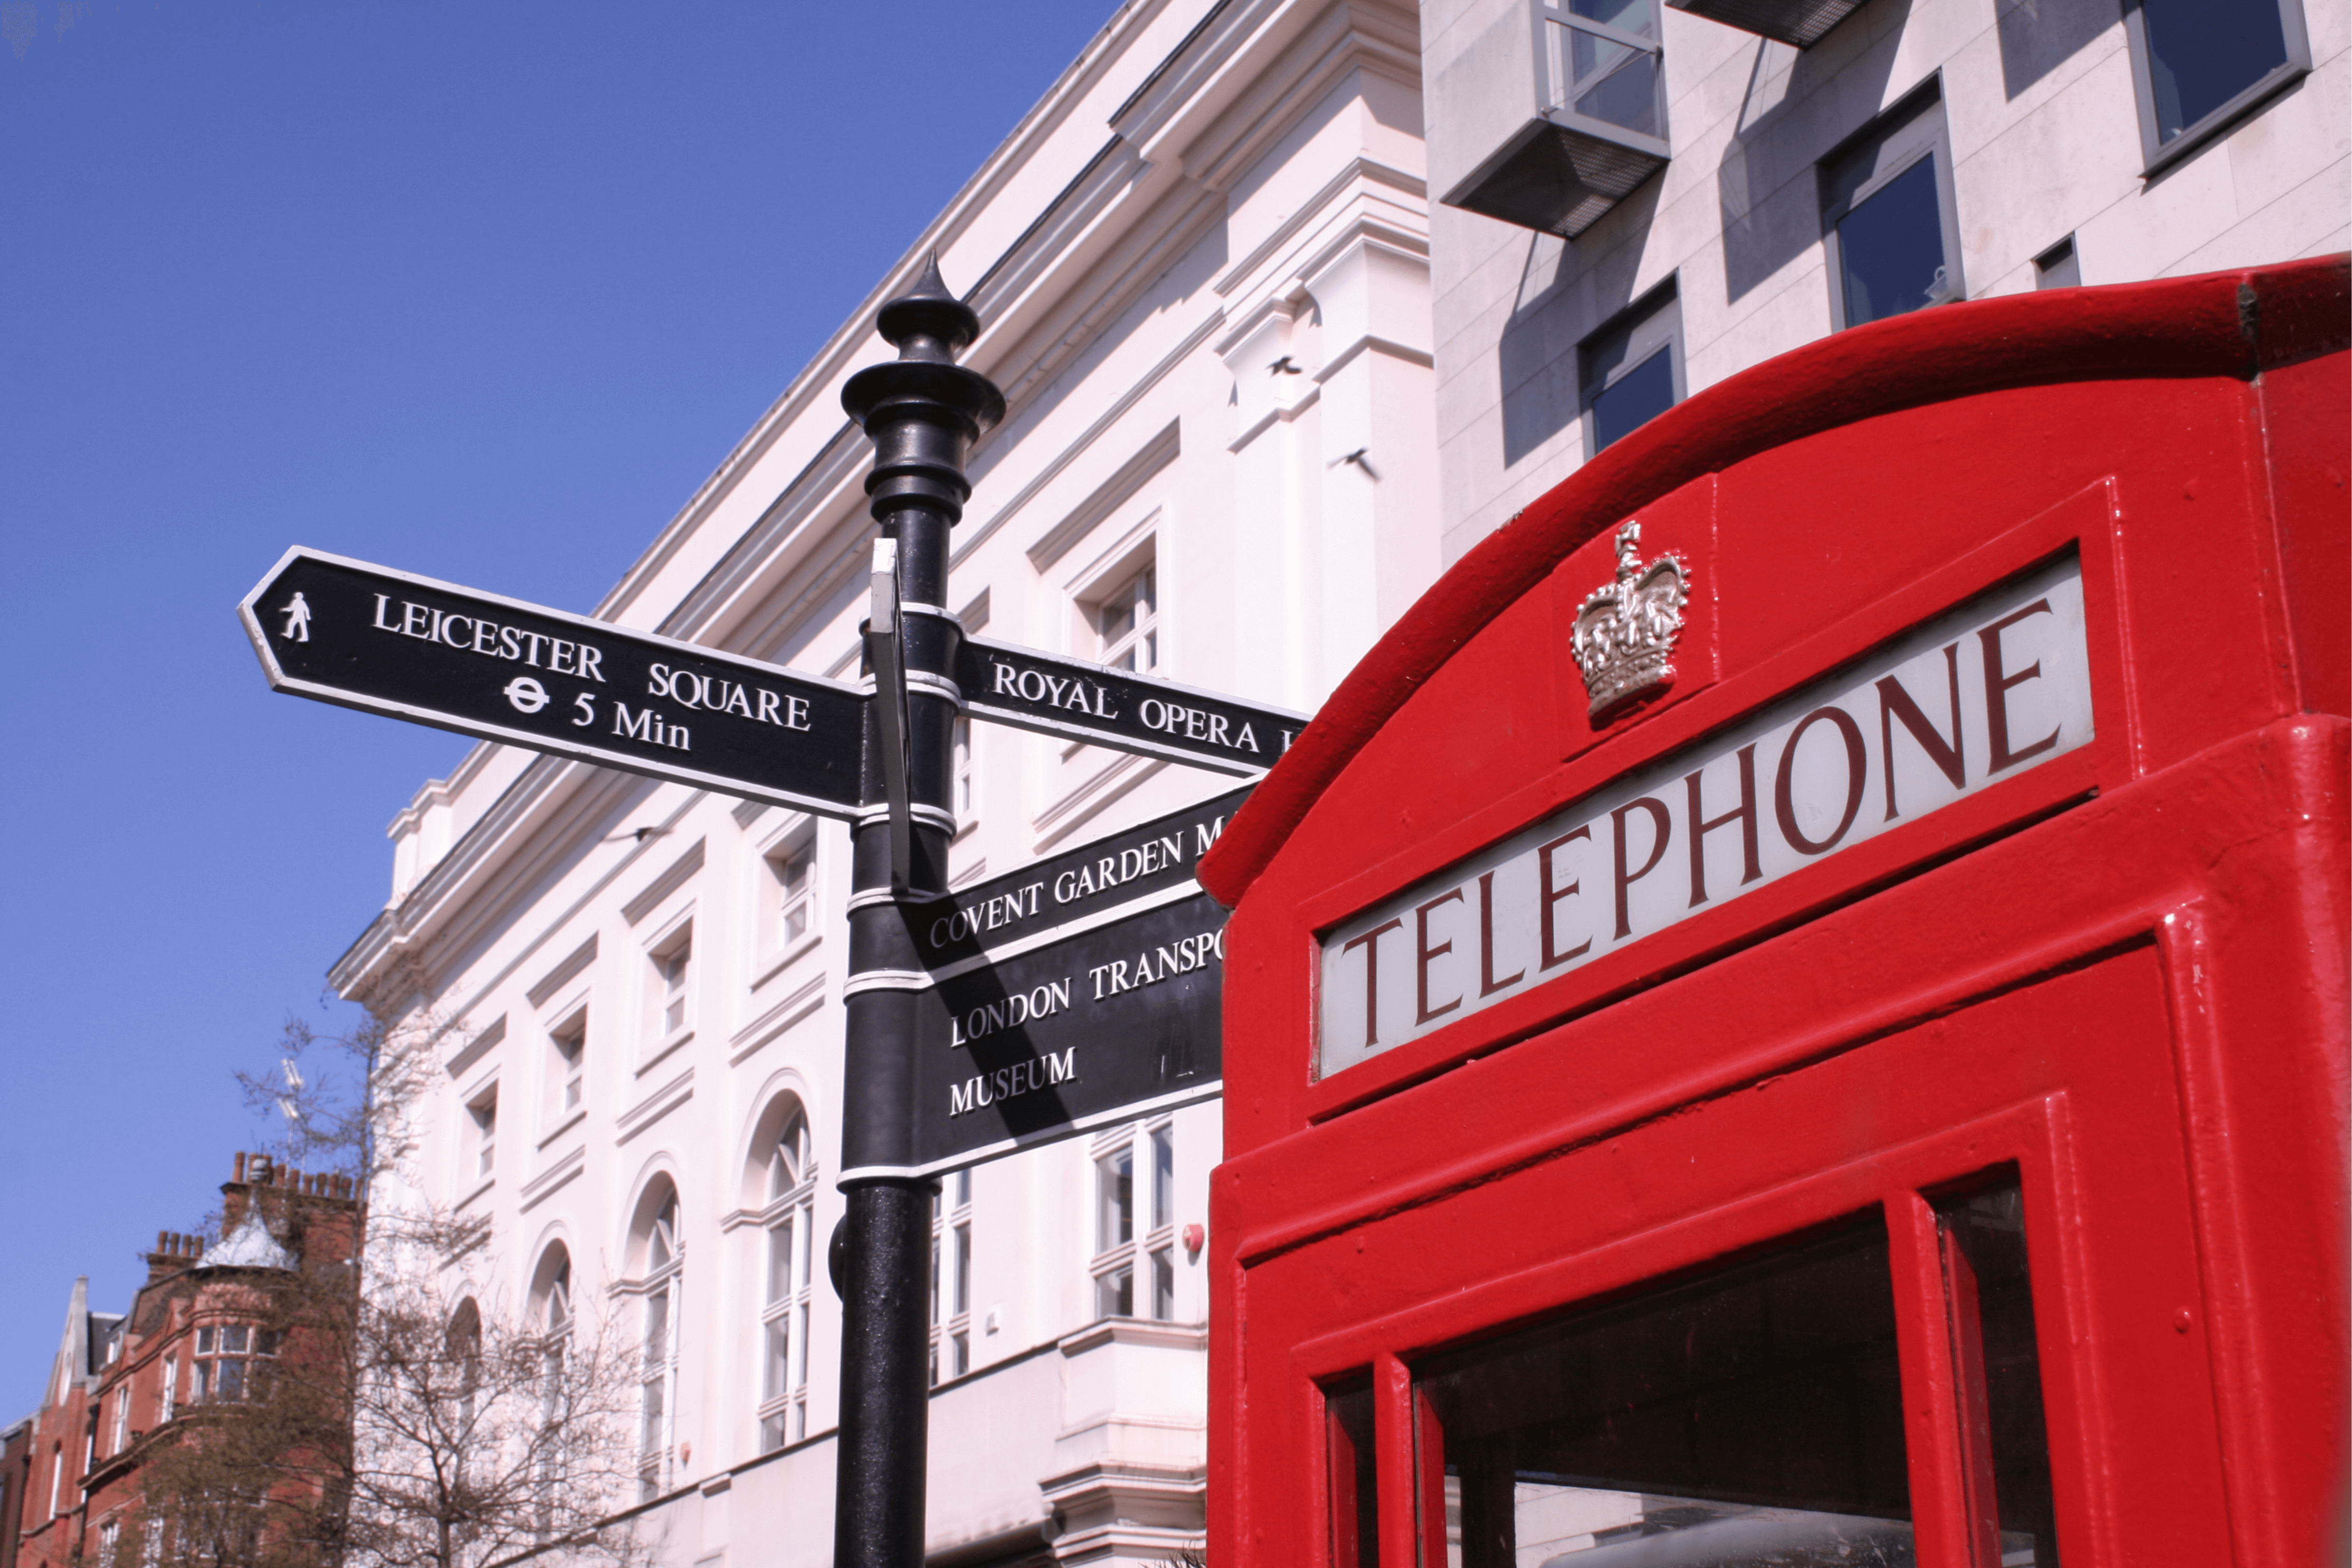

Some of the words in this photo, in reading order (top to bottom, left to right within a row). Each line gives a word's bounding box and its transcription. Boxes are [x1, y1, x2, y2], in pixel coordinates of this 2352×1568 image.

[372, 593, 607, 683] LEICESTER
[648, 663, 812, 732] SQUARE
[993, 662, 1119, 720] ROYAL
[1139, 698, 1260, 753] OPERA
[572, 692, 596, 726] 5
[612, 701, 691, 751] Min
[1342, 597, 2062, 1048] TELEPHONE
[930, 881, 1044, 948] COVENT
[1053, 830, 1185, 904] GARDEN
[950, 976, 1071, 1048] LONDON
[949, 1046, 1076, 1116] MUSEUM
